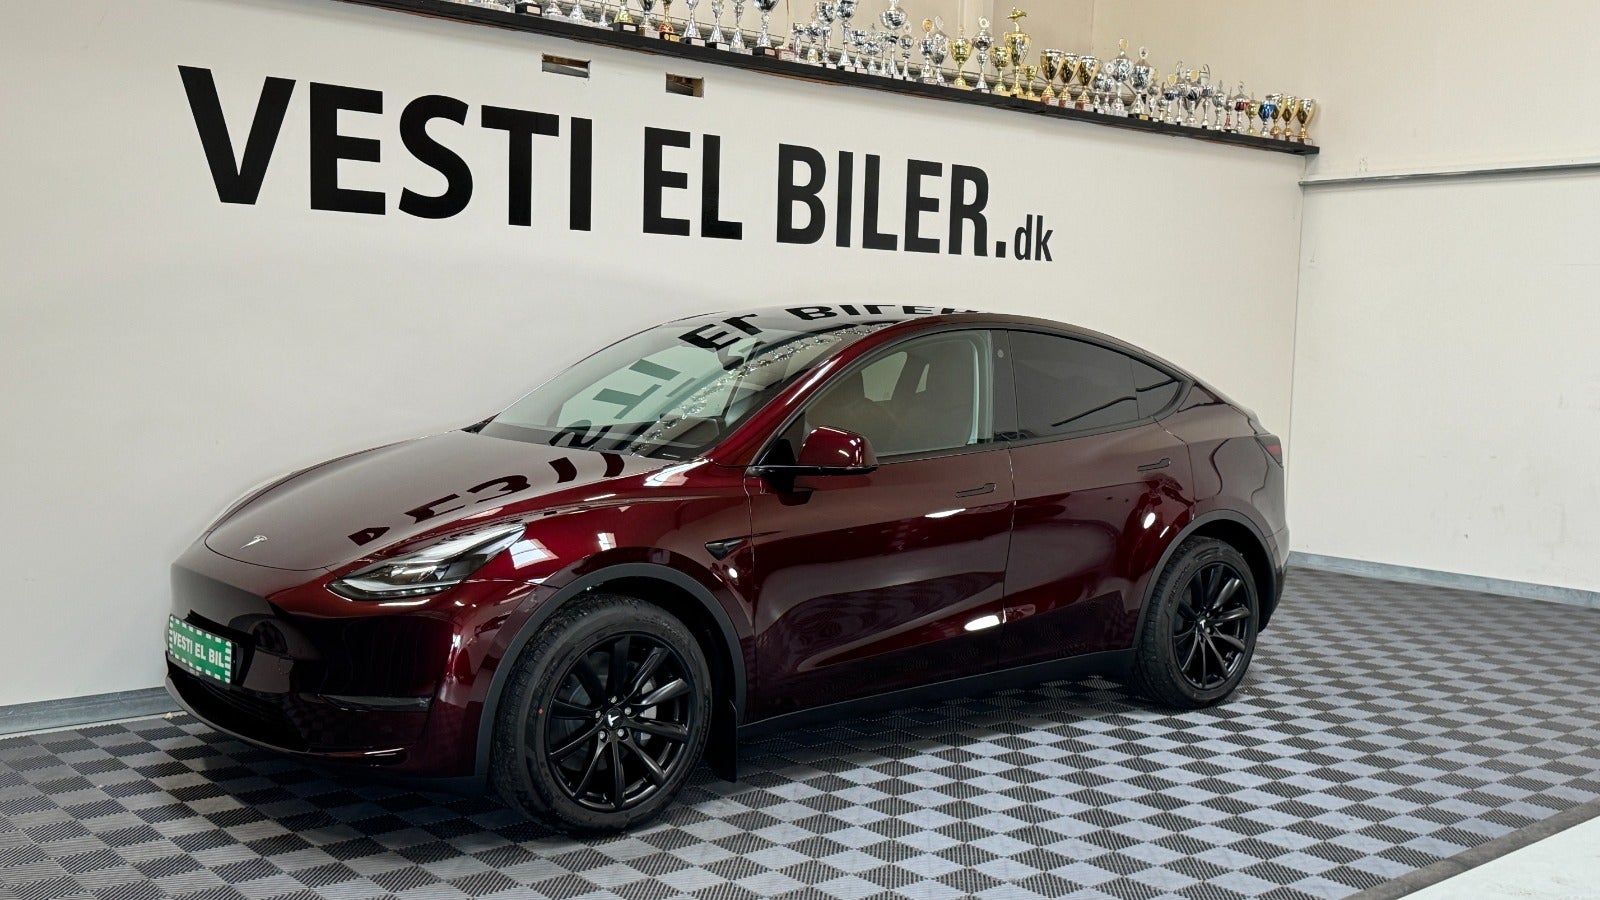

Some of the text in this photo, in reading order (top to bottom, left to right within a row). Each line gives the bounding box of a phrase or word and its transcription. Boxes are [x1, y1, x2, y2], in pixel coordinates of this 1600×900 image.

[178, 65, 593, 232] VESTI
[643, 127, 743, 241] EL
[172, 630, 193, 655] VESTI
[195, 642, 206, 661] EL
